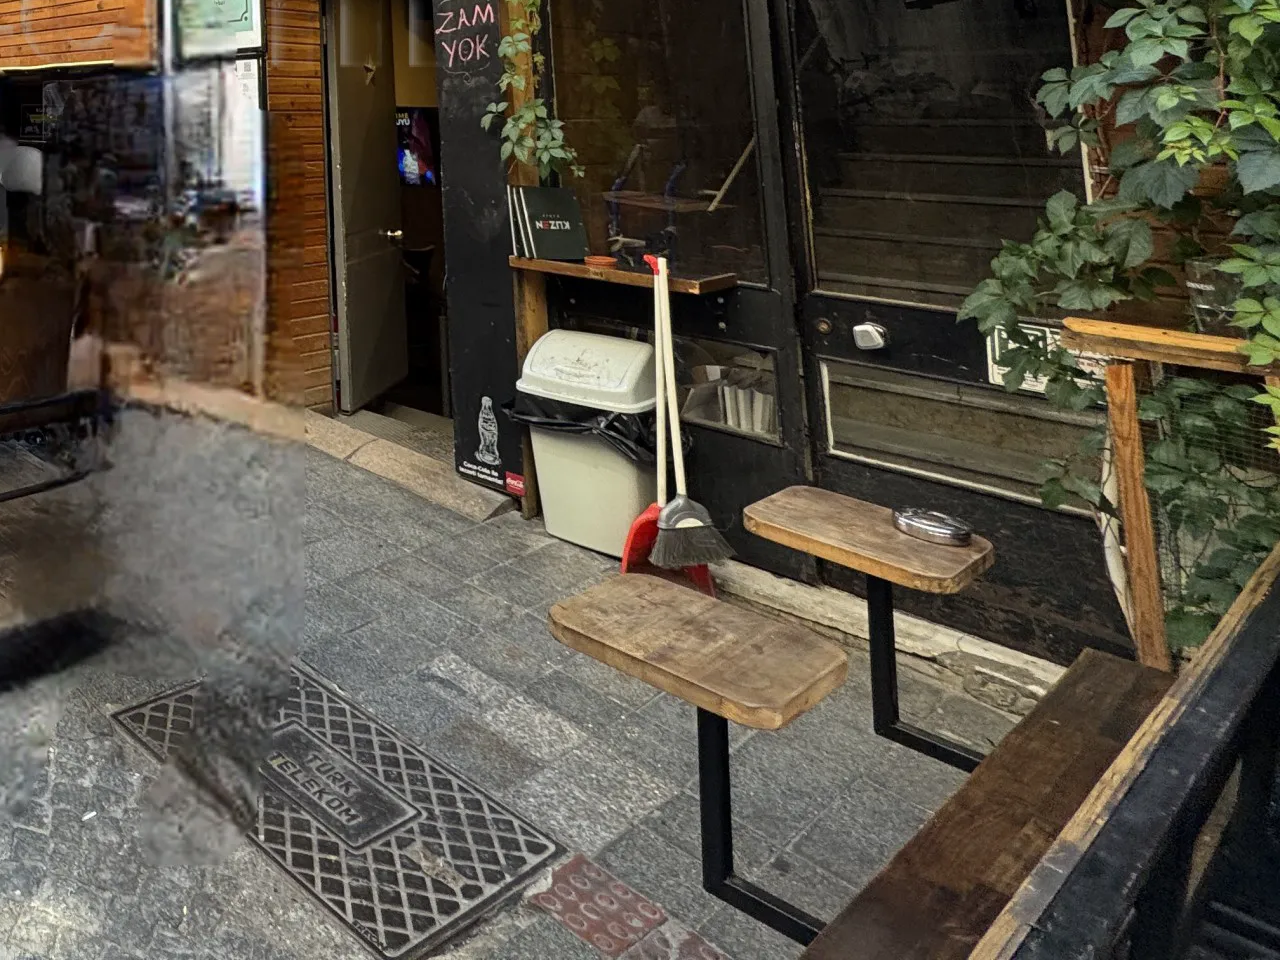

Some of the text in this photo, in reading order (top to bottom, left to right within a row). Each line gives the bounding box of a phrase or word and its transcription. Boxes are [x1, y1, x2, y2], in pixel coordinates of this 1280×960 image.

[435, 3, 495, 35] ZAM
[441, 34, 490, 68] YOK
[535, 221, 571, 230] KUZEN
[266, 750, 363, 825] TELEKOM
